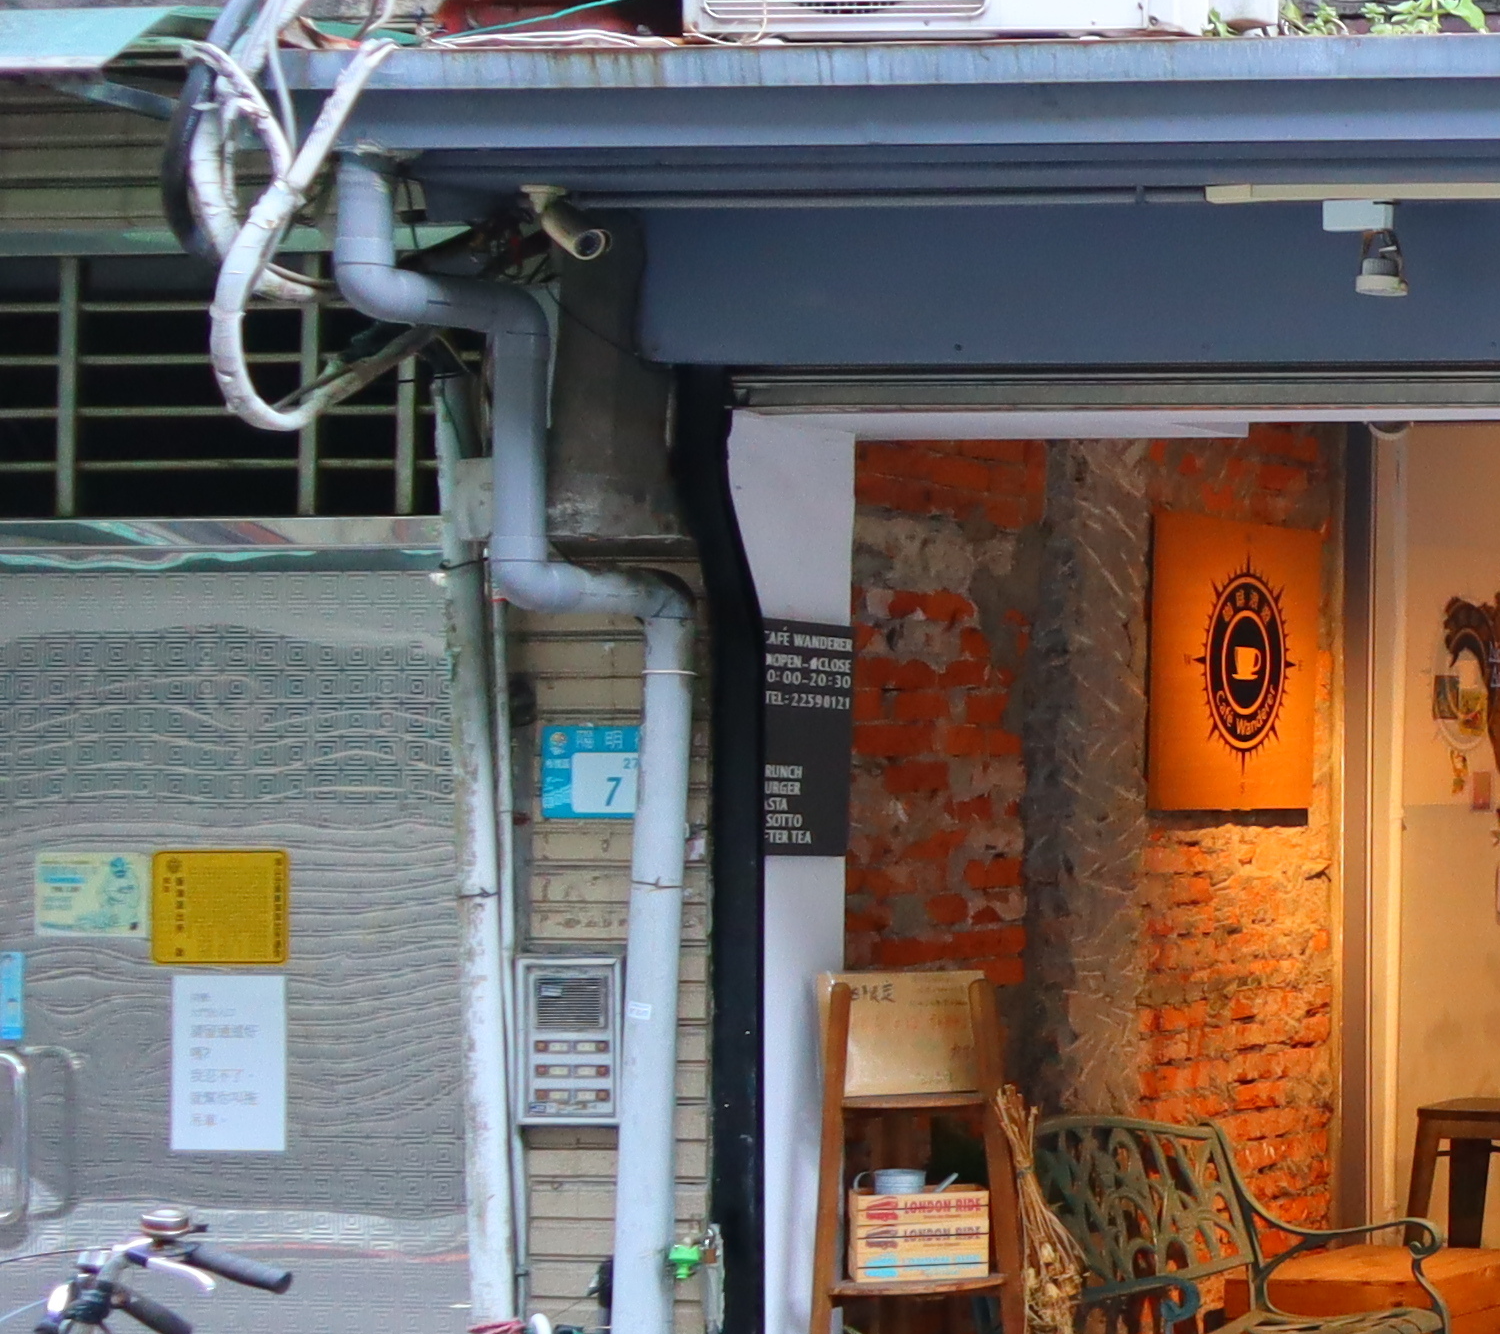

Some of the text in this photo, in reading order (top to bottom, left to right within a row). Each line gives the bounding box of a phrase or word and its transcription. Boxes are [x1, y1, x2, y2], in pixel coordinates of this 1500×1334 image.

[793, 634, 853, 652] WANDERER
[766, 669, 851, 688] 0:00-20:30
[1216, 684, 1277, 736] Café Wanderer
[576, 730, 639, 749] 陽明
[765, 764, 803, 778] RUNCH
[605, 777, 623, 806] 7
[765, 781, 801, 795] URGER
[765, 798, 788, 811] STA
[766, 814, 803, 828] SOTTO
[764, 830, 812, 844] TER TEA
[904, 1197, 981, 1214] LONDON RIDE
[904, 1226, 981, 1242] LONDON RIDE
